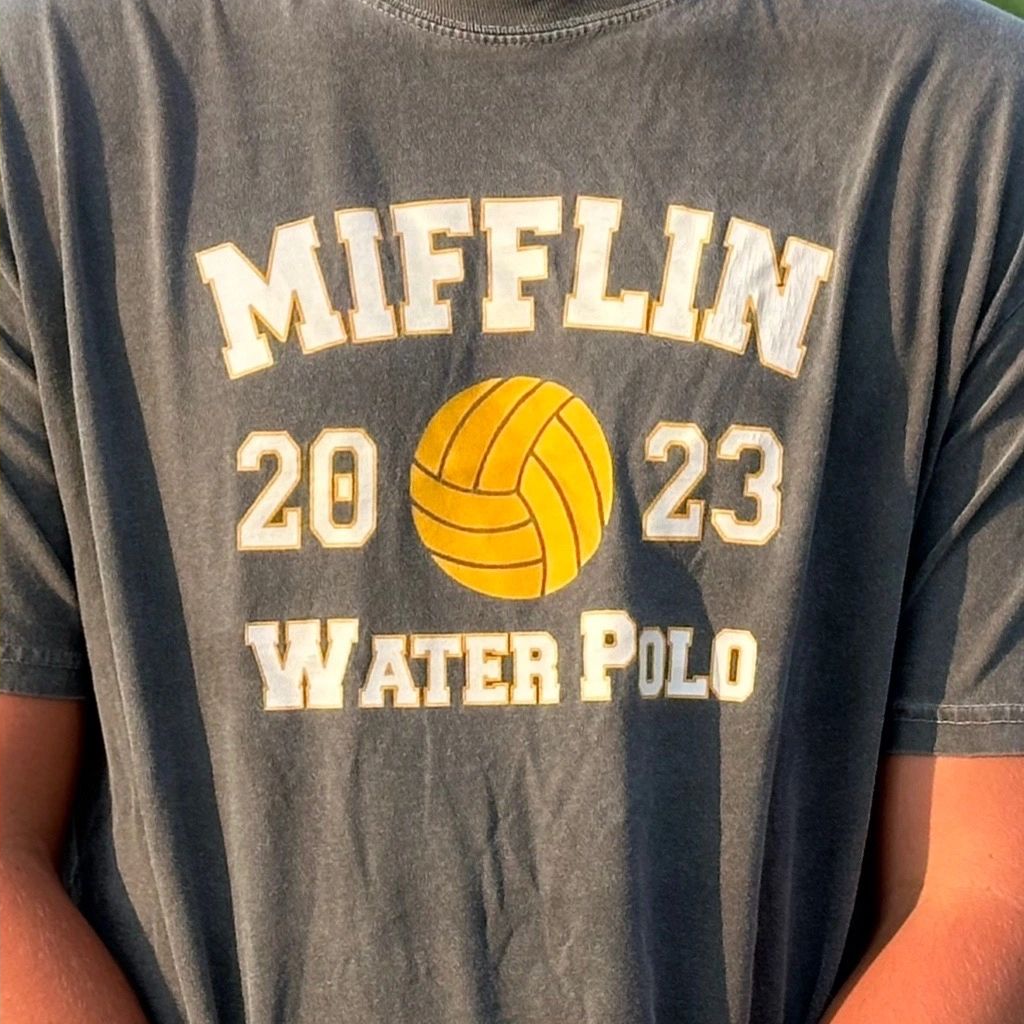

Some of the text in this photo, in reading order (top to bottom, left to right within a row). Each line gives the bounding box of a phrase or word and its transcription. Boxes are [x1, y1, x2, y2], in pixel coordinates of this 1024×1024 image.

[195, 195, 834, 378] MIFFLIN
[236, 421, 784, 551] 20 23
[244, 609, 758, 711] WATER POLO
